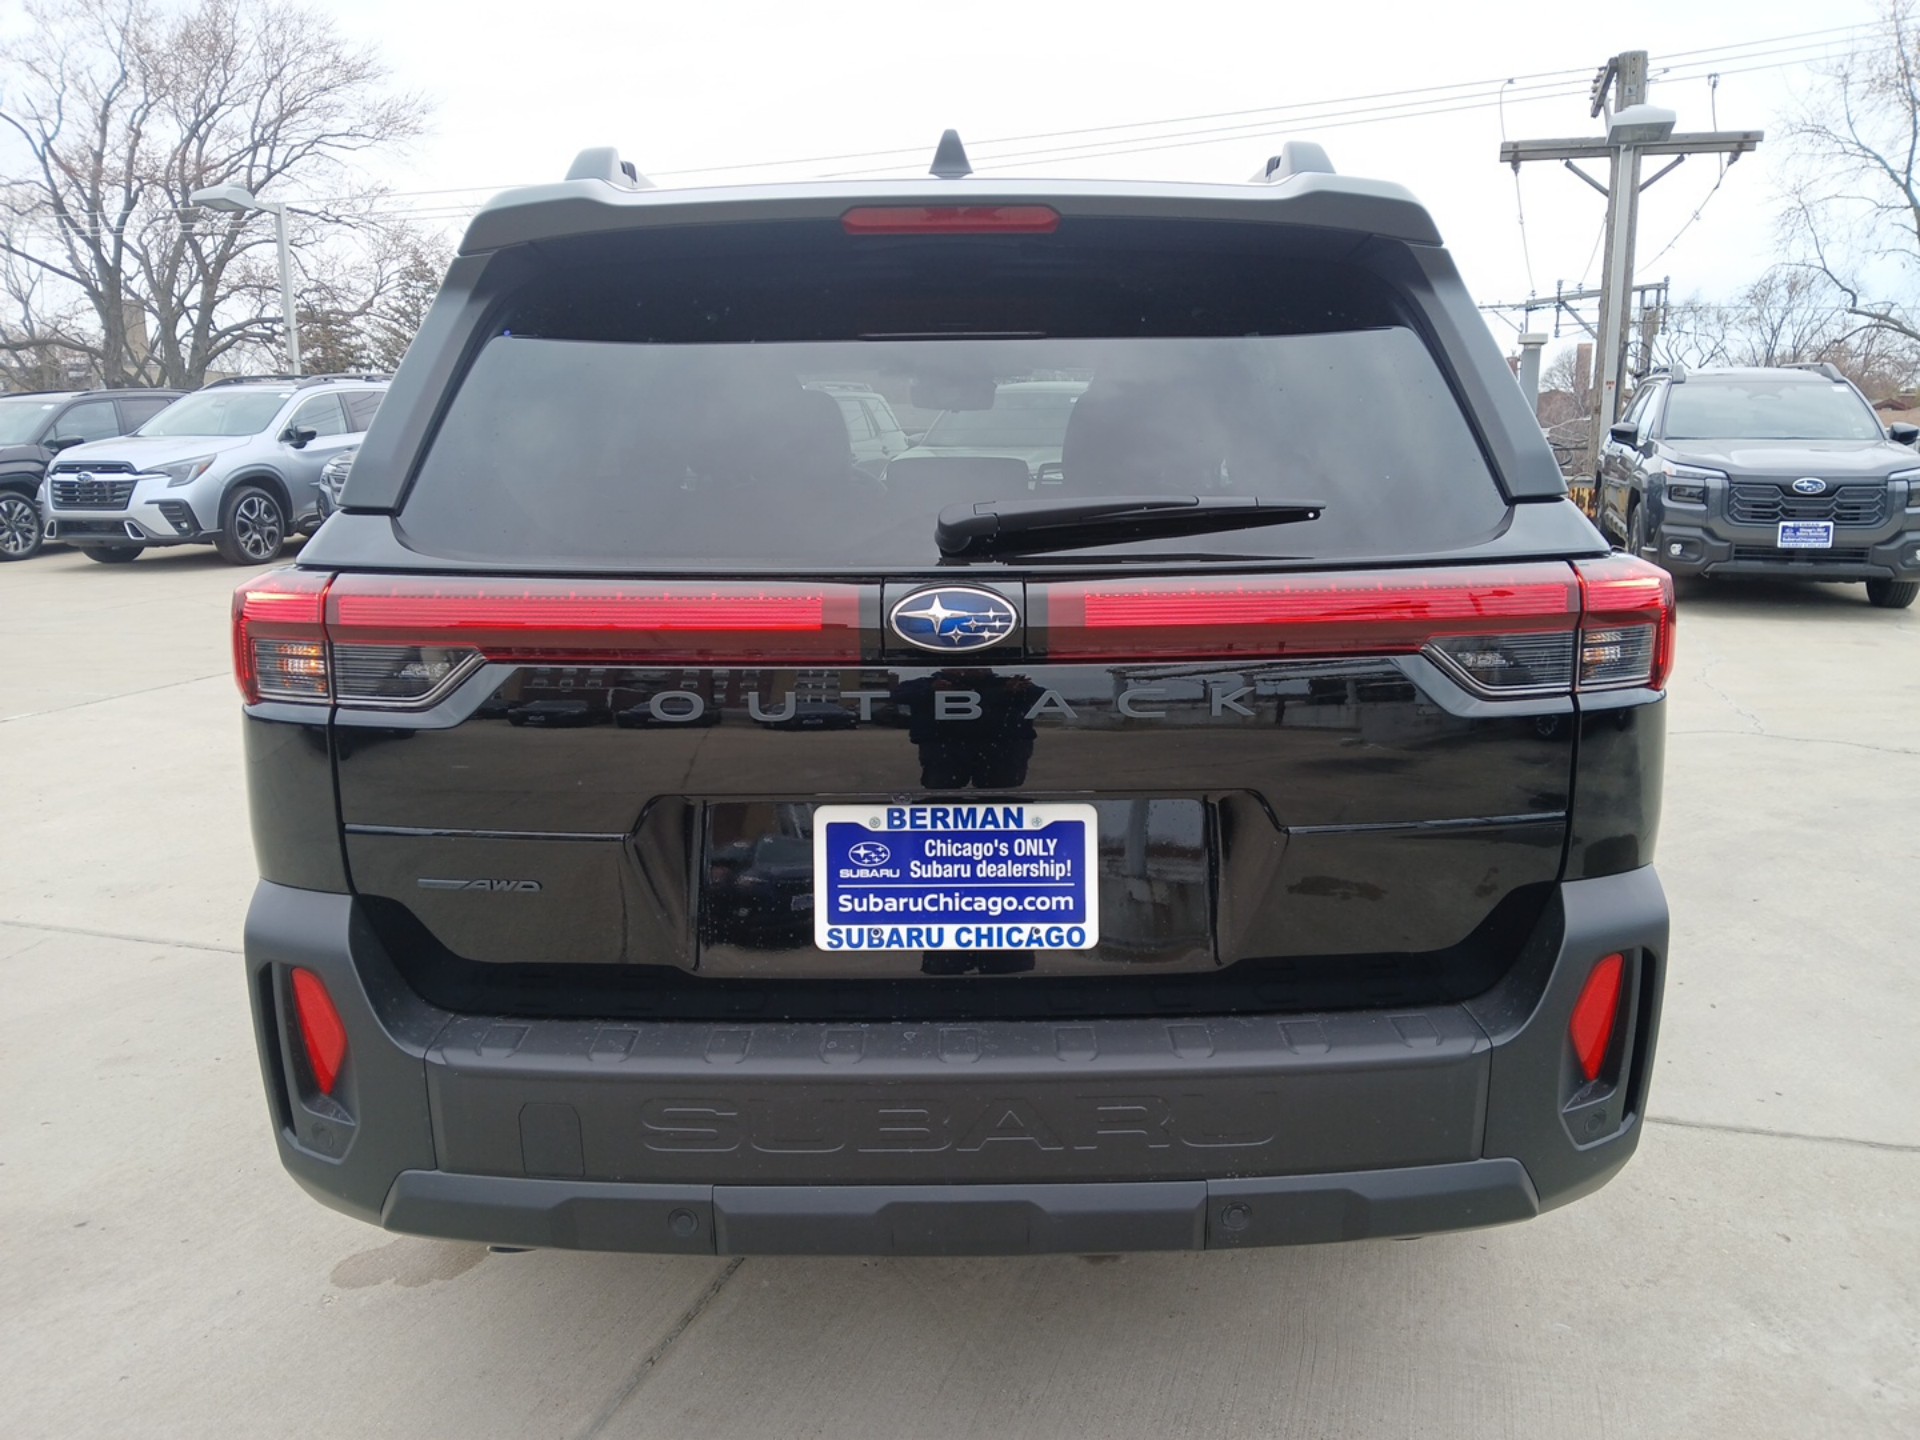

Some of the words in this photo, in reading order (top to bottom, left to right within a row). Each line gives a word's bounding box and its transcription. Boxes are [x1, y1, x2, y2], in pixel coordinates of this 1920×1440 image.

[649, 687, 1257, 722] OUTBACK
[887, 806, 1024, 829] BERMAN
[924, 839, 1009, 860] Chicago's
[1014, 839, 1058, 857] ONLY
[839, 869, 900, 878] SUBARU
[910, 860, 971, 879] Subaru
[976, 859, 1072, 880] dealership!
[462, 879, 542, 892] AWD
[838, 894, 1074, 916] SubaruChicago.com
[827, 928, 944, 949] SUBARU
[955, 926, 1086, 948] CHICAGO
[642, 1094, 1278, 1153] SUBARU
